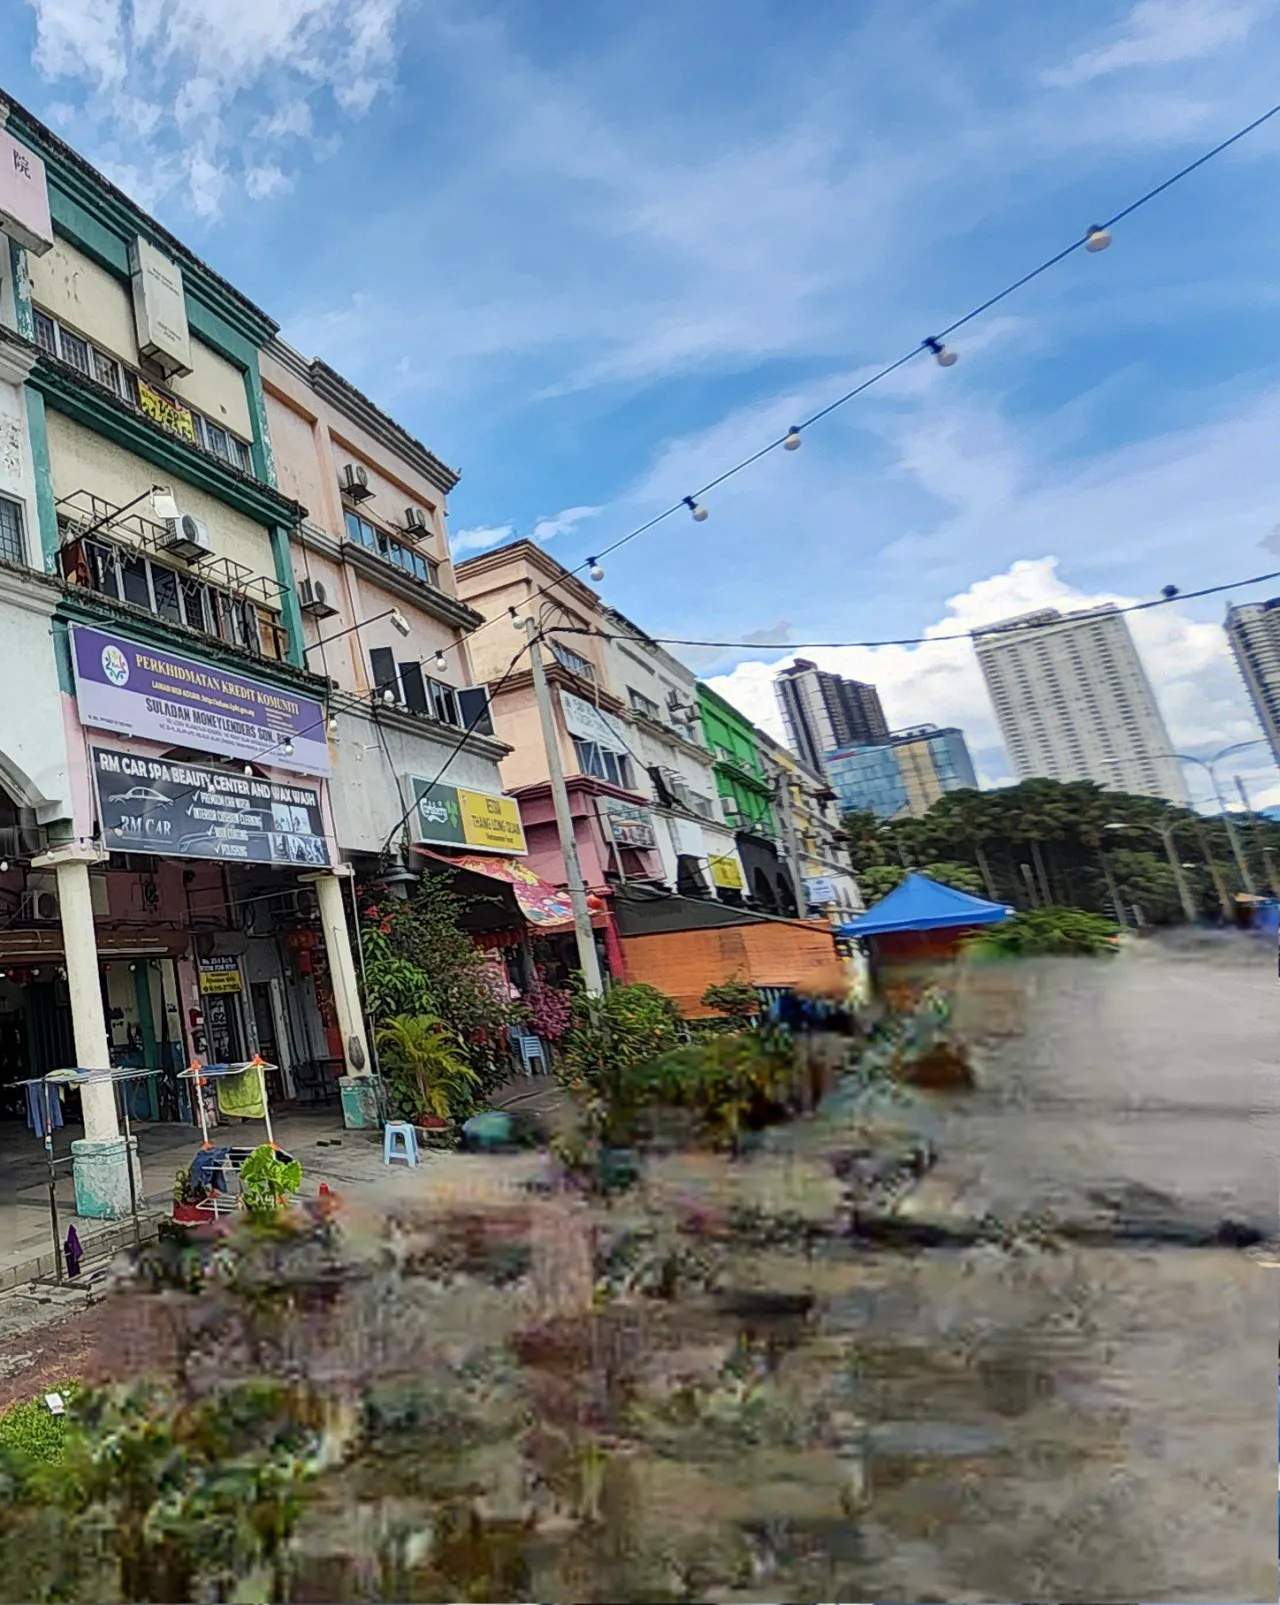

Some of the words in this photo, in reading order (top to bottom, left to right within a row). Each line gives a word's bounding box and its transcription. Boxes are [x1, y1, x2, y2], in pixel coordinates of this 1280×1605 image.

[135, 653, 221, 690] PERKHIDMATAN
[222, 680, 256, 702] KREDIT
[257, 692, 300, 716] KOMUNITI
[145, 697, 191, 722] SULADAN
[192, 709, 257, 739] MONEYLENDERS
[99, 753, 121, 773] RM
[121, 758, 147, 778] CAR
[148, 761, 171, 782] SPA
[172, 769, 212, 789] BEAUTY
[213, 776, 250, 796] CENTER
[251, 783, 271, 799] AND
[271, 785, 293, 803] WAX
[293, 789, 316, 807] WASH
[120, 815, 142, 832] RM
[145, 817, 172, 835] CAR
